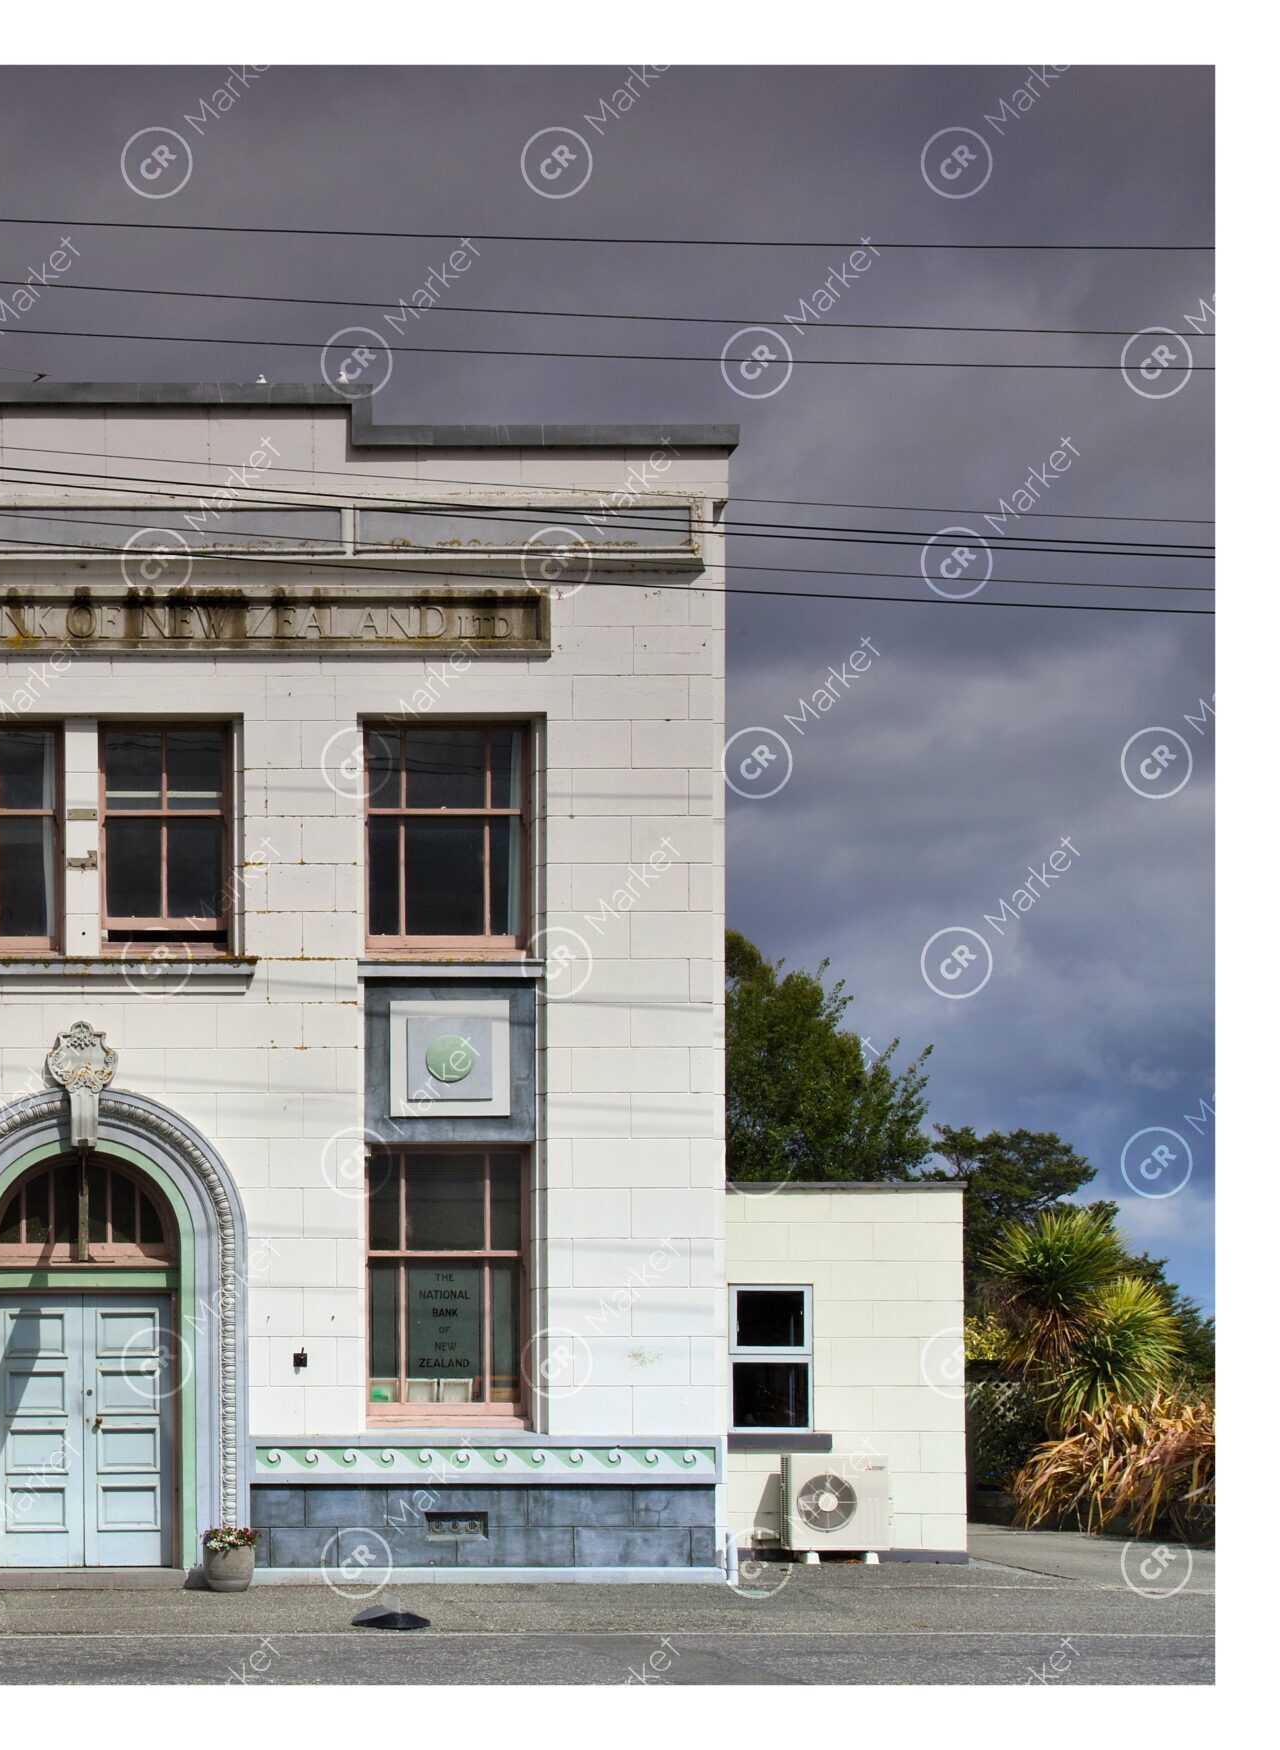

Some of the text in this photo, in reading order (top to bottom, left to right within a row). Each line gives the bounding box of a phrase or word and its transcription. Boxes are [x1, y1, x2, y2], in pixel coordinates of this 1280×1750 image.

[66, 604, 120, 639] OF
[140, 604, 232, 639] NEW
[246, 604, 449, 639] ZEALAND
[458, 614, 514, 639] LTD
[435, 1273, 455, 1282] THE
[419, 1289, 471, 1300] NATIONAL
[432, 1308, 458, 1318] BANK
[438, 1326, 451, 1335] OF
[434, 1341, 457, 1351] NEW
[418, 1358, 470, 1368] ZEALAND
